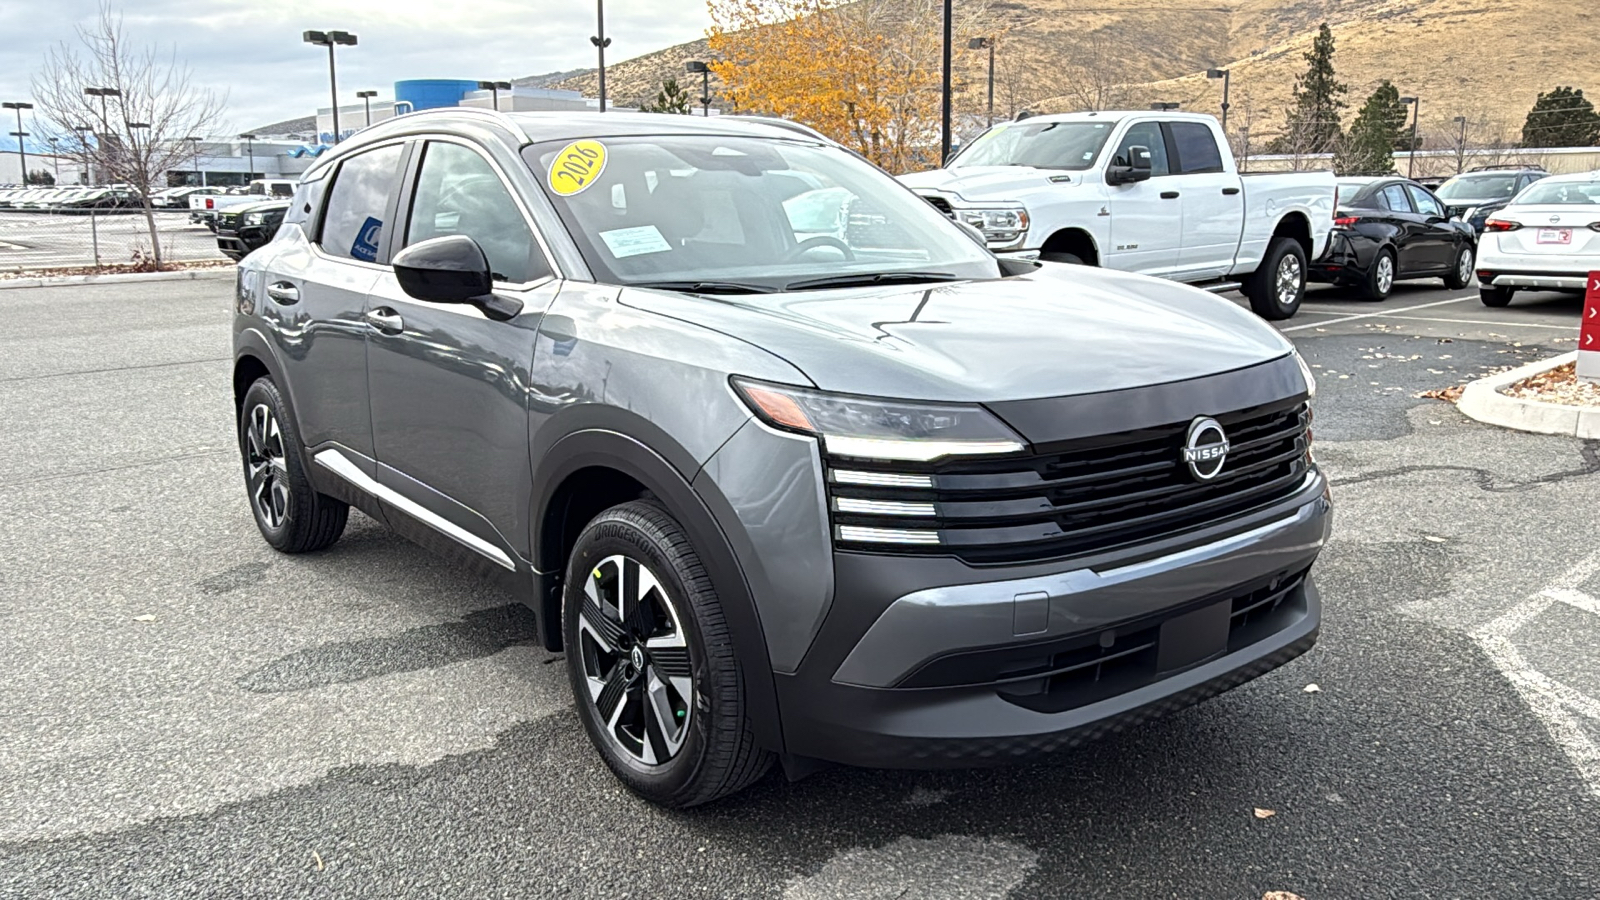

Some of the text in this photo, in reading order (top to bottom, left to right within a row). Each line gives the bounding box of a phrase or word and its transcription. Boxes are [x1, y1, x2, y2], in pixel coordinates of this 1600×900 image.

[557, 144, 599, 186] 2026
[1187, 446, 1230, 460] NISSAN
[594, 524, 664, 566] BRIDGESTONE
